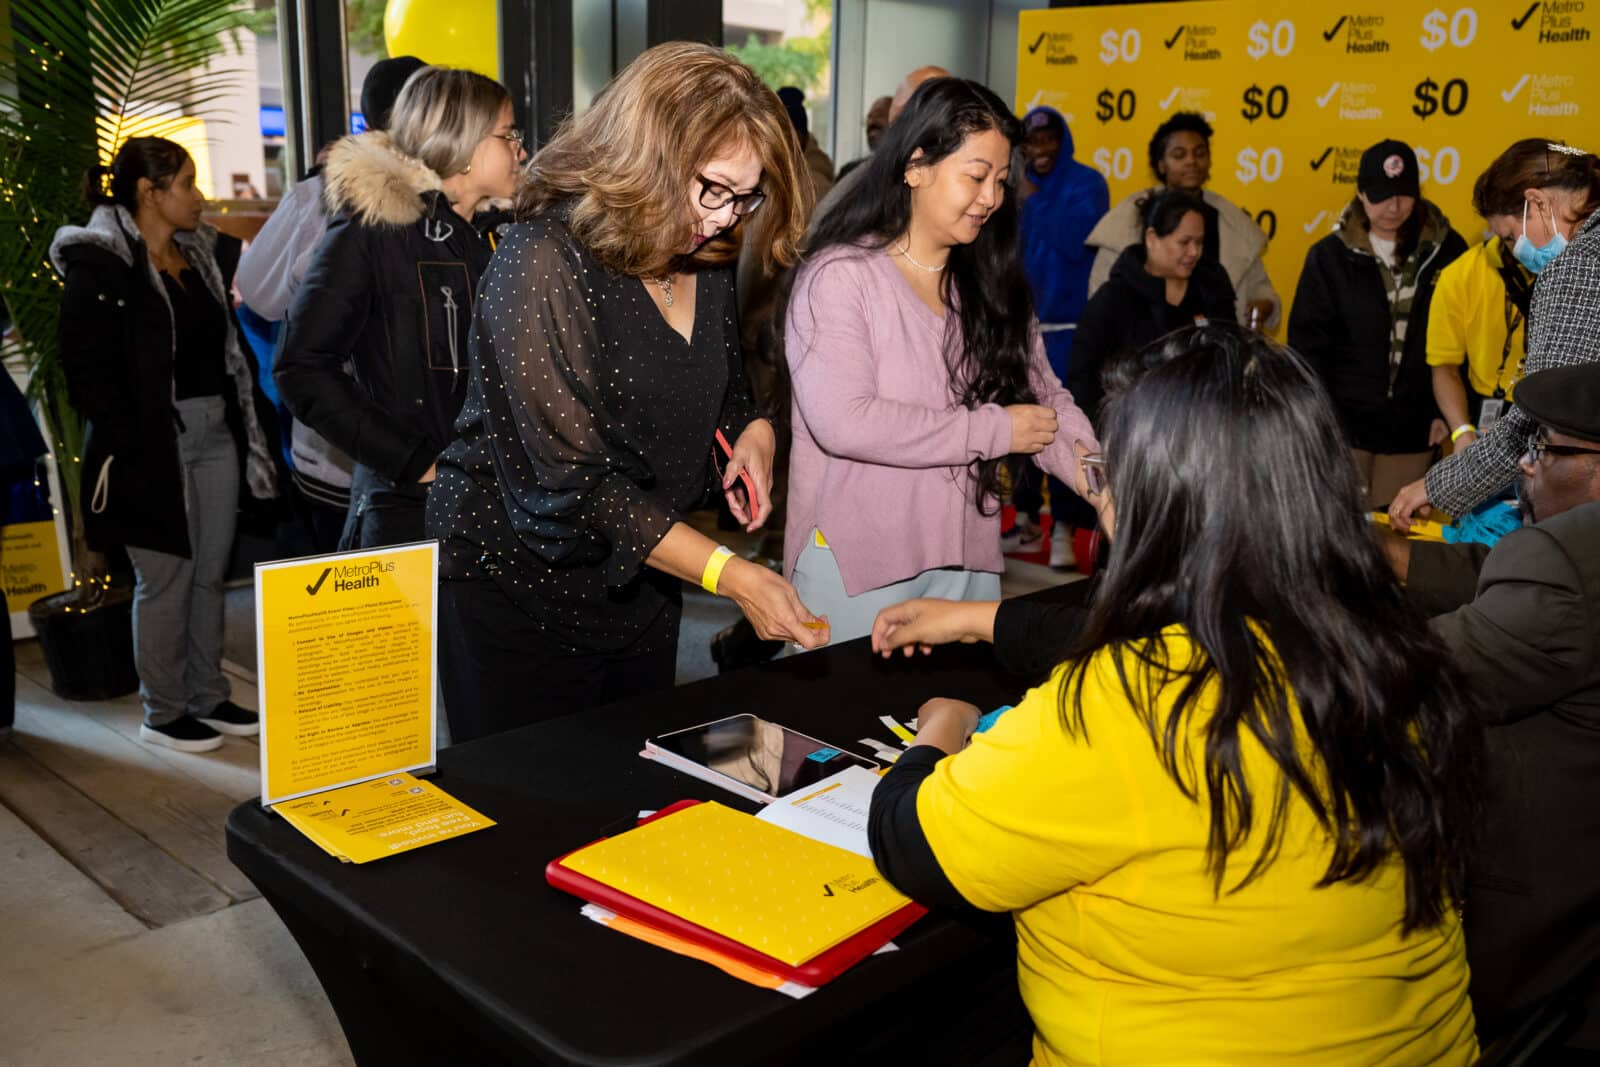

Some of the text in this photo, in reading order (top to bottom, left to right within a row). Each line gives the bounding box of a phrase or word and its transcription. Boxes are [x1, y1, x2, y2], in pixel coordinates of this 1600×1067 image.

[1542, 1, 1584, 14] Metro
[1348, 15, 1384, 27] Metro
[1540, 14, 1571, 28] Plus
[1187, 24, 1216, 36] Metro
[1348, 28, 1374, 40] Plus
[1420, 8, 1478, 51] $0
[1538, 28, 1590, 44] Health
[1100, 28, 1141, 64] $0
[1185, 37, 1207, 48] Plus
[1247, 20, 1295, 60] $0
[1346, 40, 1390, 54] Health
[1045, 54, 1078, 66] Health
[1184, 48, 1221, 61] Health
[1532, 74, 1574, 87] Metro
[1412, 77, 1469, 121] $0
[1530, 87, 1560, 101] Plus
[1096, 88, 1136, 125] $0
[1241, 84, 1289, 124] $0
[1528, 101, 1579, 117] Health
[1339, 106, 1382, 120] Health
[1093, 147, 1133, 181] $0
[1236, 146, 1283, 185] $0
[1332, 172, 1359, 185] Hea
[334, 561, 395, 580] MetroPlus
[7, 584, 47, 596] Health
[334, 575, 379, 592] Health
